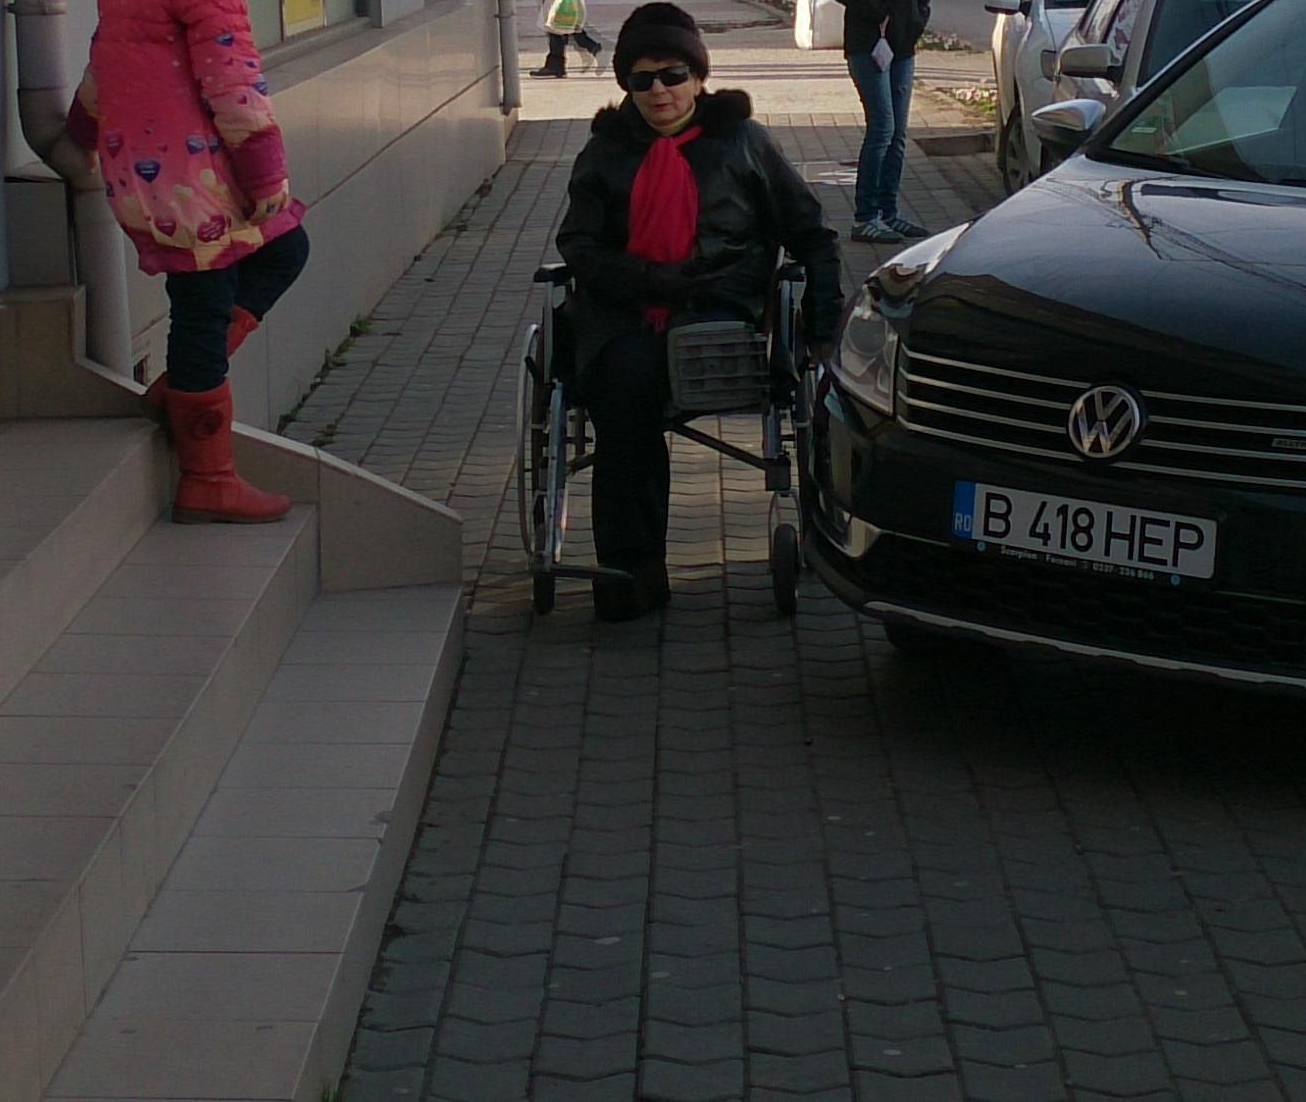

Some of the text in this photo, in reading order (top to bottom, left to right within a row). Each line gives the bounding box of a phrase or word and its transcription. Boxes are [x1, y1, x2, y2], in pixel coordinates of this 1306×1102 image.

[953, 492, 1205, 567] RO B 418 HEP
